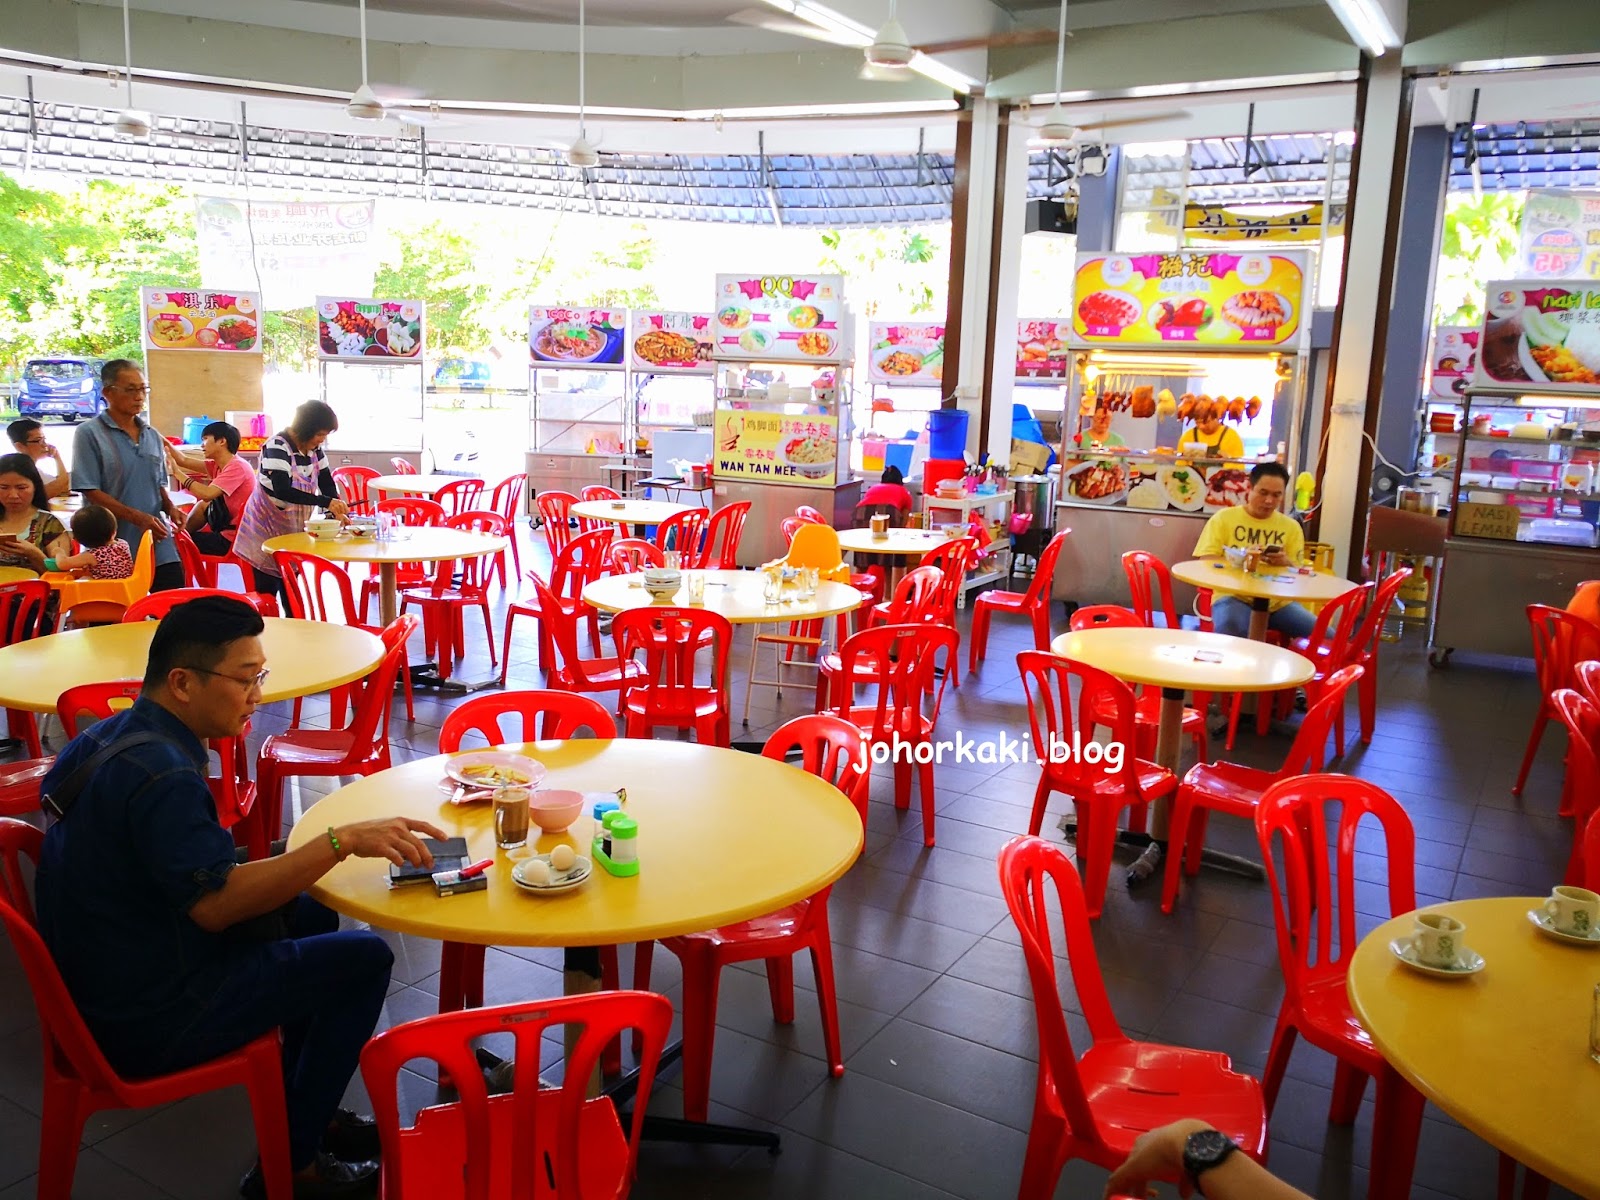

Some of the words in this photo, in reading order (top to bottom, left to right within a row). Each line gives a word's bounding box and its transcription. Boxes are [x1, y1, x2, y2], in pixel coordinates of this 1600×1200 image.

[760, 275, 795, 299] QQ
[1542, 290, 1583, 309] nasi
[720, 460, 744, 472] WAN
[749, 463, 770, 475] TAN
[774, 465, 797, 477] MEE
[1473, 506, 1511, 521] NASI
[1234, 525, 1286, 545] CMYK
[1460, 520, 1515, 536] LEMAK
